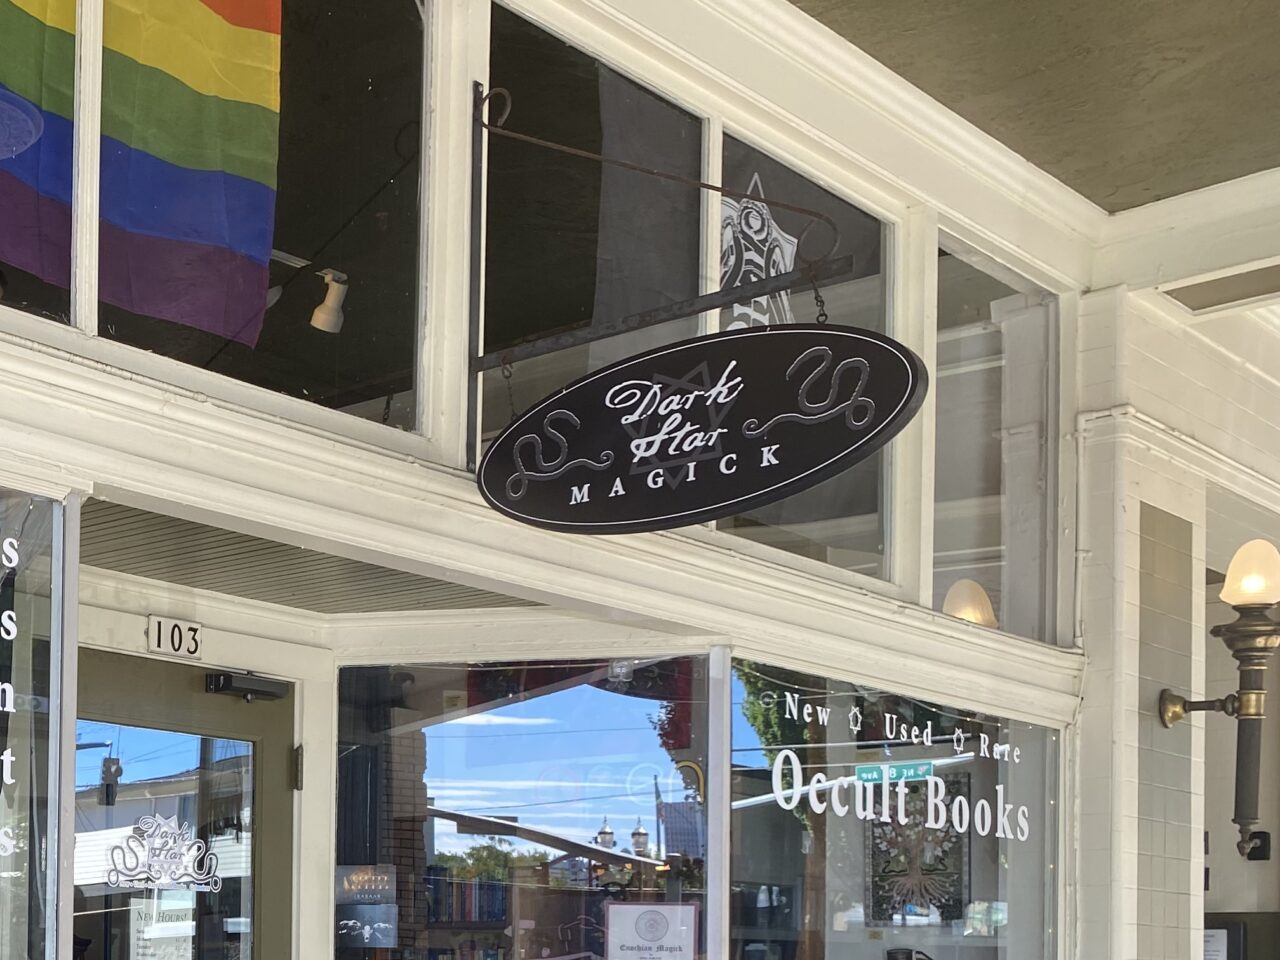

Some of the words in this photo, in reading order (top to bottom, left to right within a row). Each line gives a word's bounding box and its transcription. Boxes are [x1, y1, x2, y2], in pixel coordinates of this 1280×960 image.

[605, 359, 744, 423] Dark
[631, 417, 730, 463] Star
[569, 444, 780, 505] MAGICK
[157, 620, 199, 655] 103
[784, 690, 831, 727] New
[884, 713, 934, 746] Used
[979, 731, 1022, 764] Rare
[771, 748, 910, 827] Occult
[925, 773, 1031, 843] Books
[139, 816, 189, 841] Dark
[151, 840, 186, 860] Star
[158, 911, 187, 923] HOURS!
[620, 944, 652, 952] Enochian
[656, 945, 683, 953] Magick
